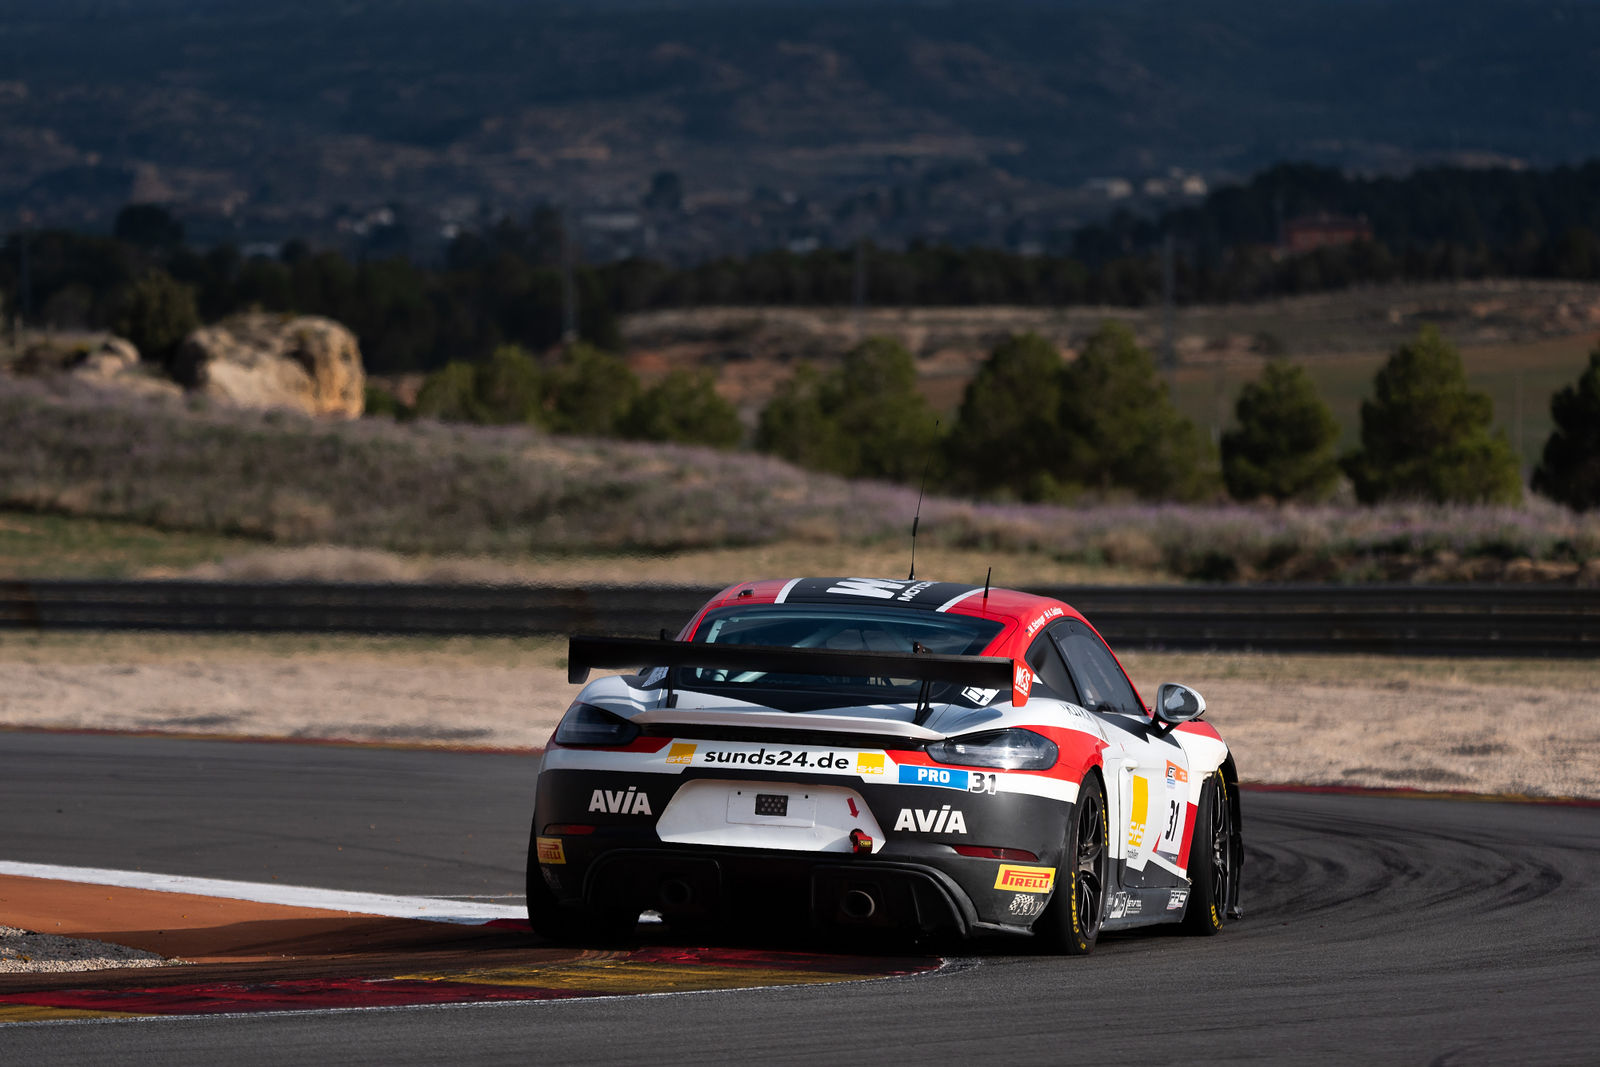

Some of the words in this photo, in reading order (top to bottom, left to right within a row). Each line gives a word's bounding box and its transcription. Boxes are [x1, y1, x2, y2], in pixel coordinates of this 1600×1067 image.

[704, 748, 849, 769] sunds24.de
[917, 768, 950, 784] PRO
[971, 772, 997, 794] 31
[1165, 800, 1180, 842] 31
[1001, 869, 1050, 889] PIRELLI
